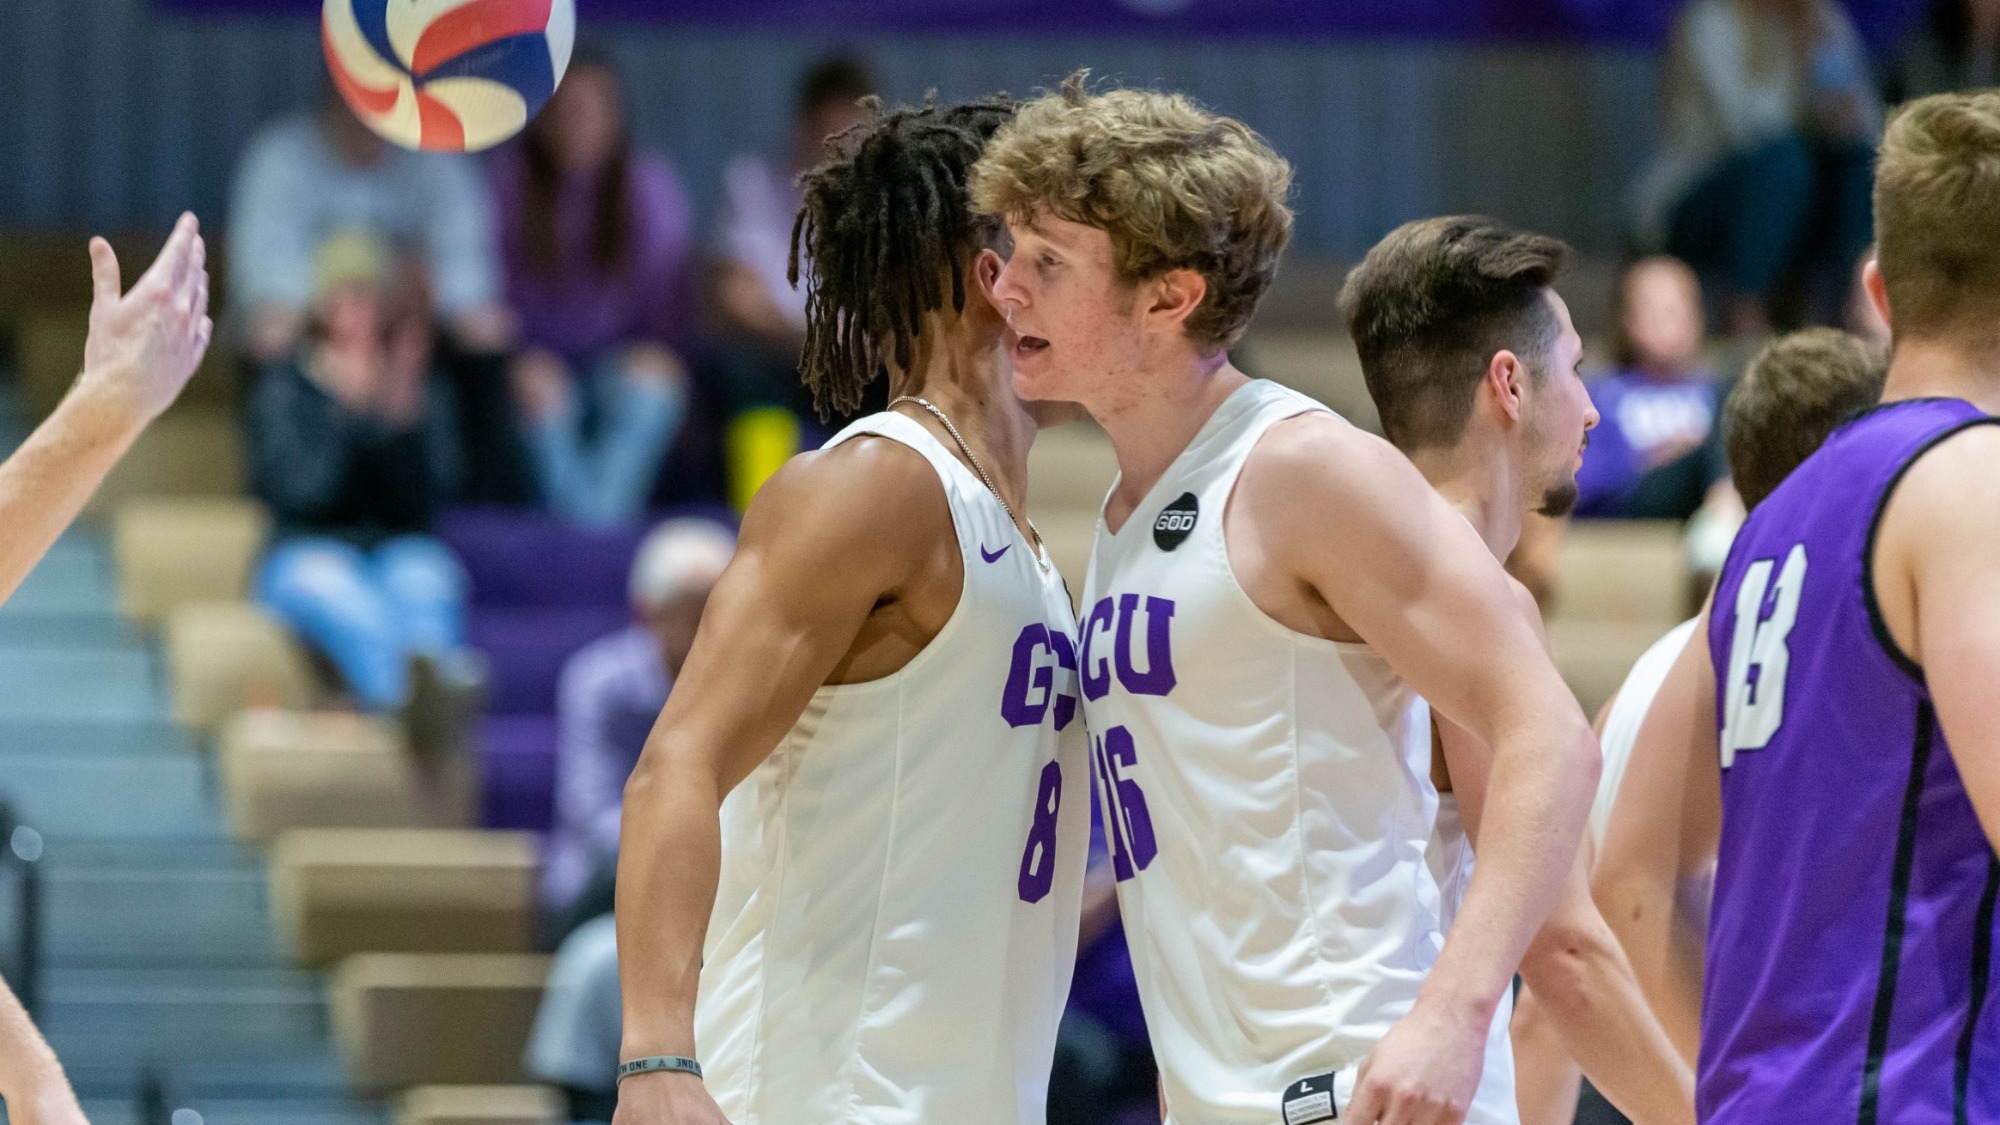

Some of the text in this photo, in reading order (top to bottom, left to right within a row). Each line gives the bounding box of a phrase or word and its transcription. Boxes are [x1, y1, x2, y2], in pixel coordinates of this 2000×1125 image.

[1155, 515, 1195, 531] GOD
[1078, 593, 1178, 702] CU
[1018, 758, 1062, 904] 8
[1096, 725, 1158, 884] 16
[629, 1059, 648, 1072] ONE
[1300, 1081, 1313, 1093] L
